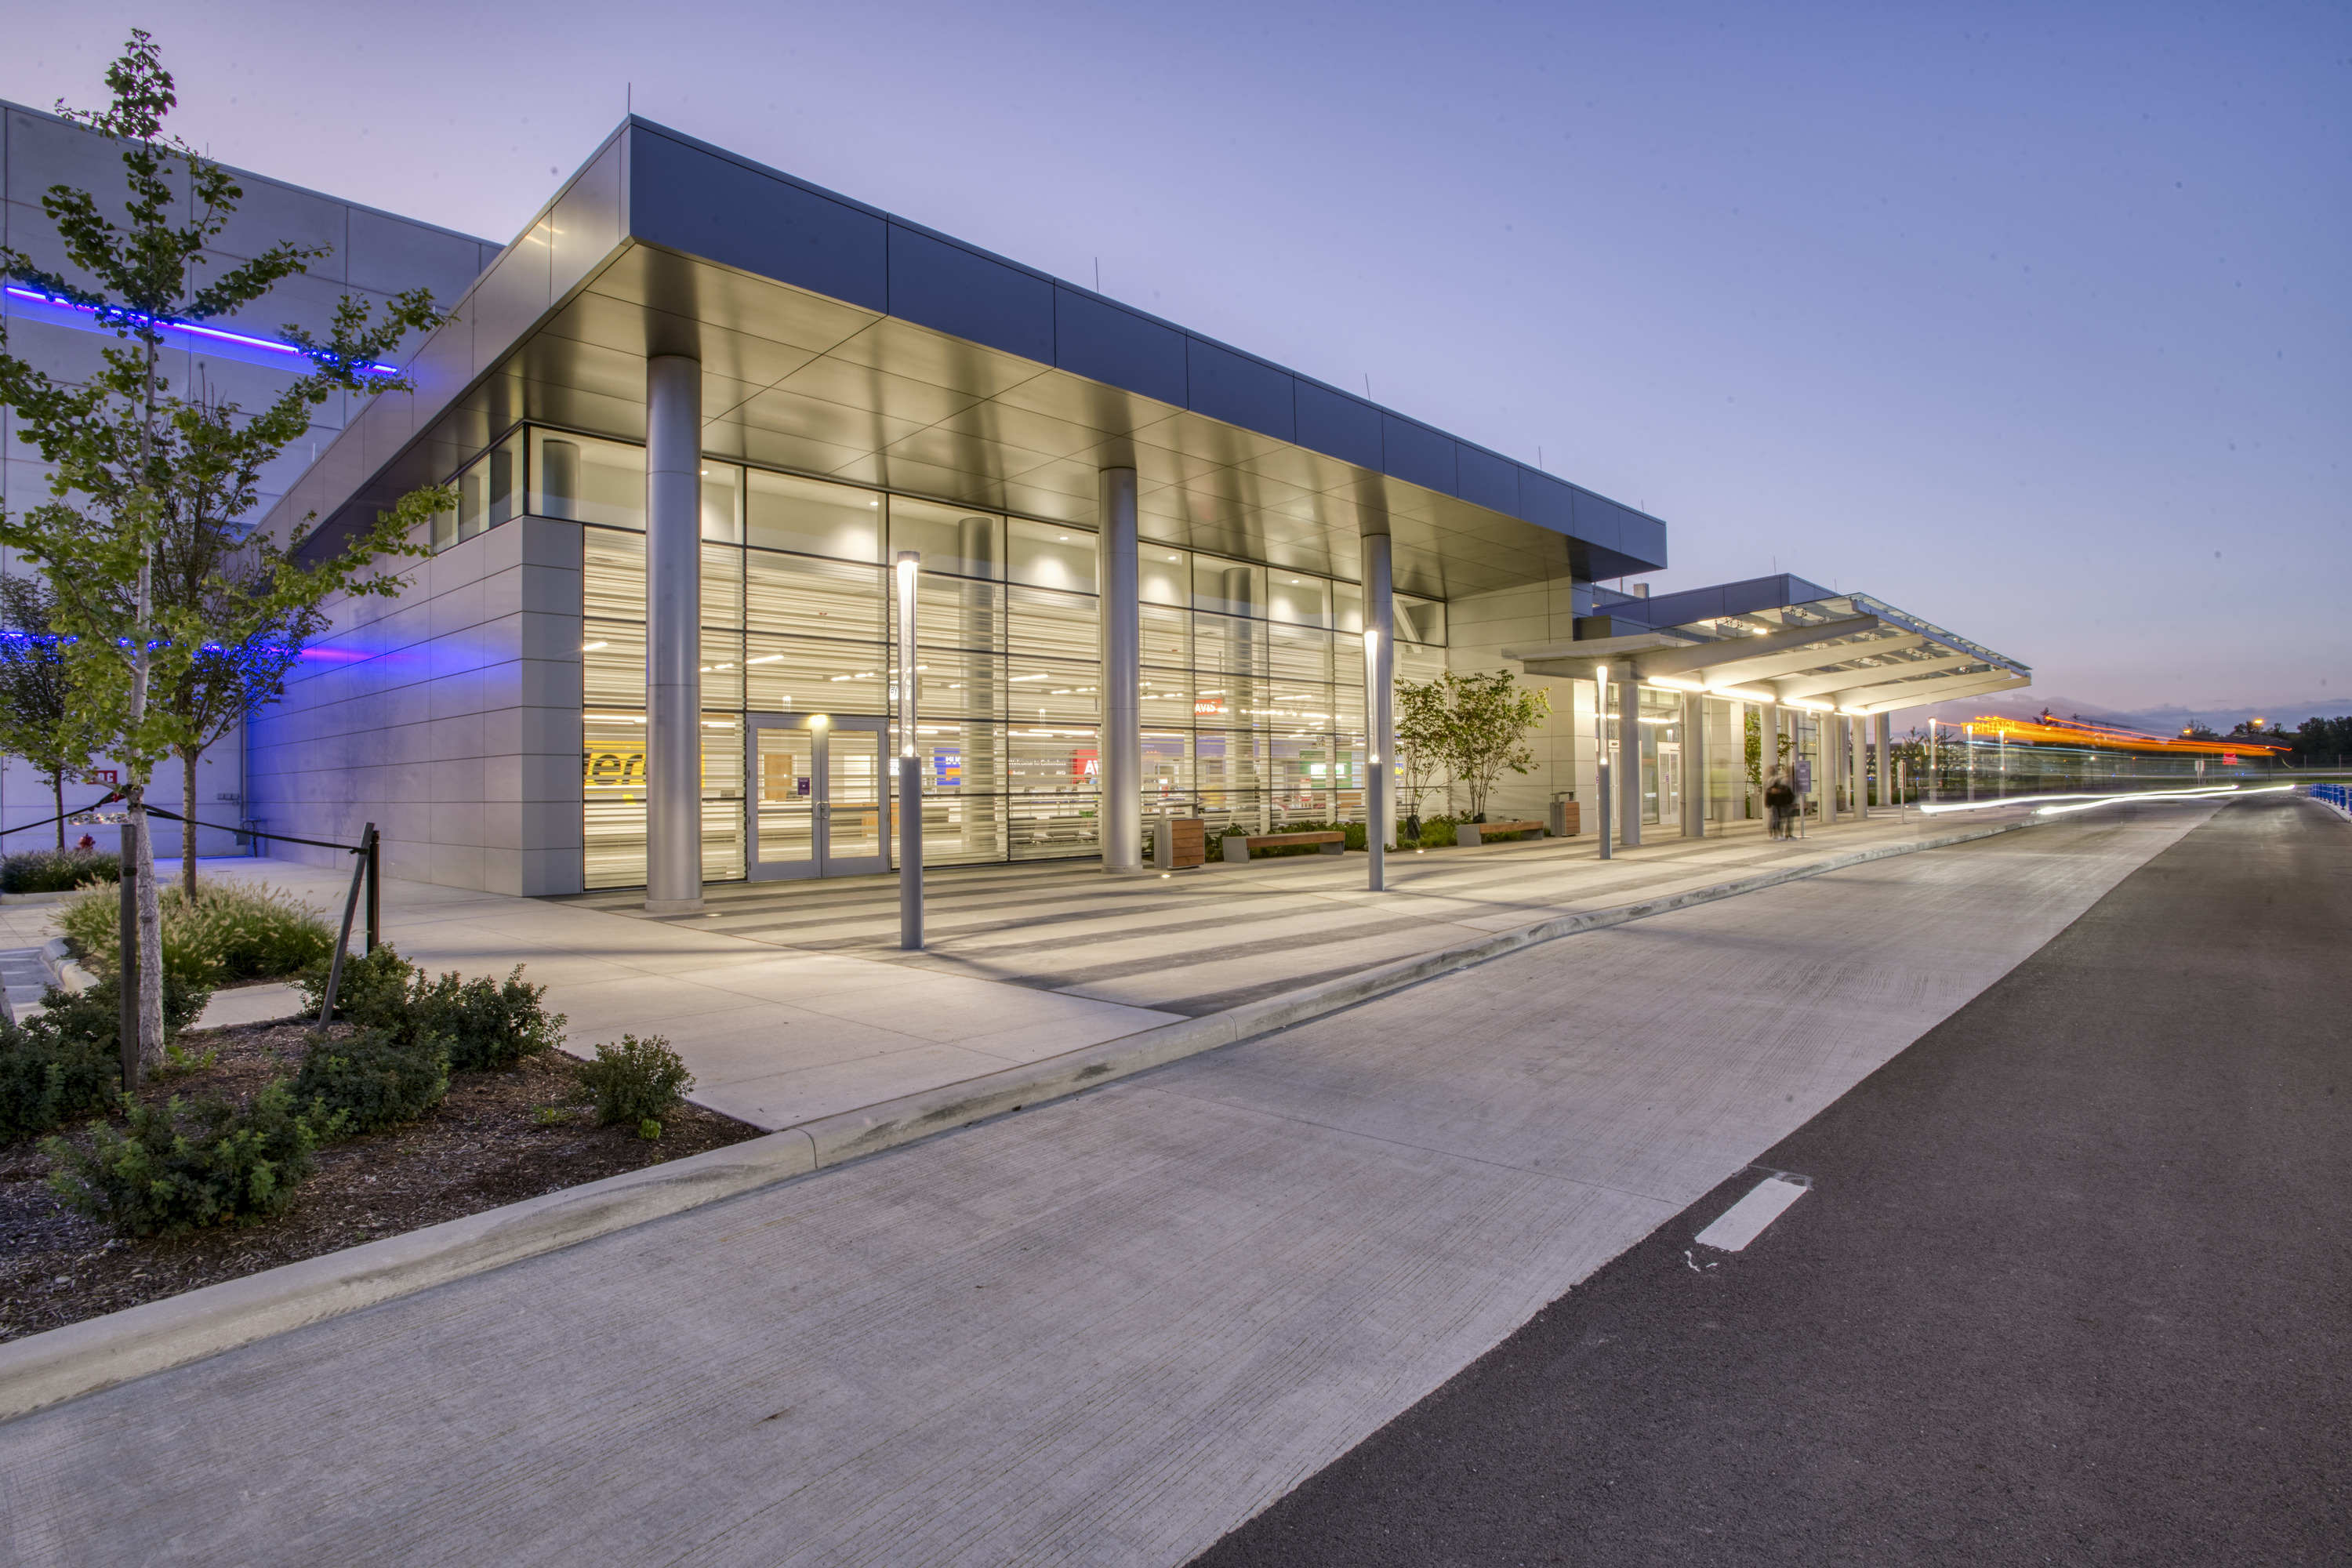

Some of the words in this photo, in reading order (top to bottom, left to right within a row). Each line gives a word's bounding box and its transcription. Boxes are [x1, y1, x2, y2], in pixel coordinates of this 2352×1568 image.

[1195, 703, 1216, 713] AVIS
[1961, 721, 2019, 734] TERMINAL
[584, 753, 646, 786] er
